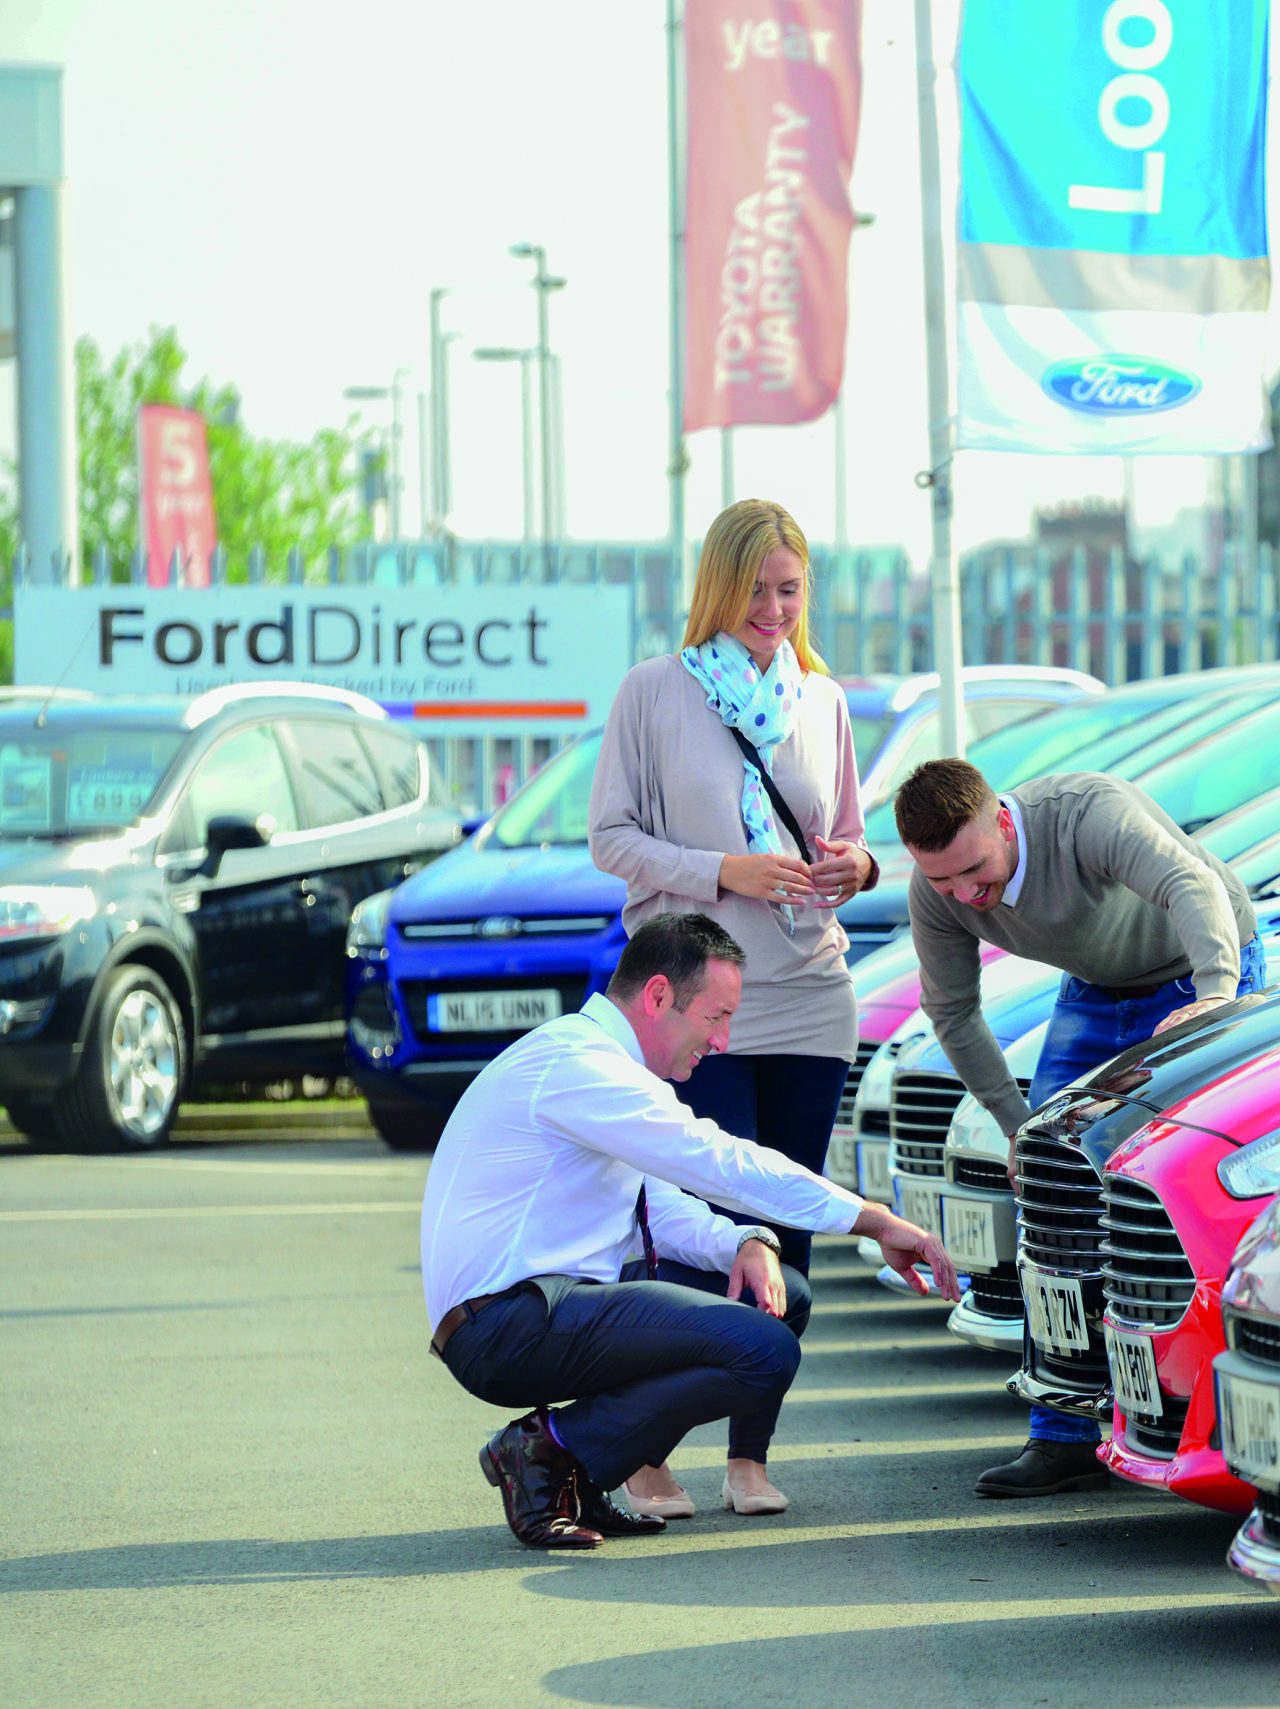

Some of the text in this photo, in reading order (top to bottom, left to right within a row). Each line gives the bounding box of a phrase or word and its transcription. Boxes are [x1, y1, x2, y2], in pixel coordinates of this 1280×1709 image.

[723, 19, 834, 71] year
[755, 102, 811, 393] WARRANTY
[713, 190, 764, 393] TOYOTA
[1070, 361, 1168, 404] Ford
[161, 421, 197, 485] 5
[98, 603, 549, 668] FordDirect
